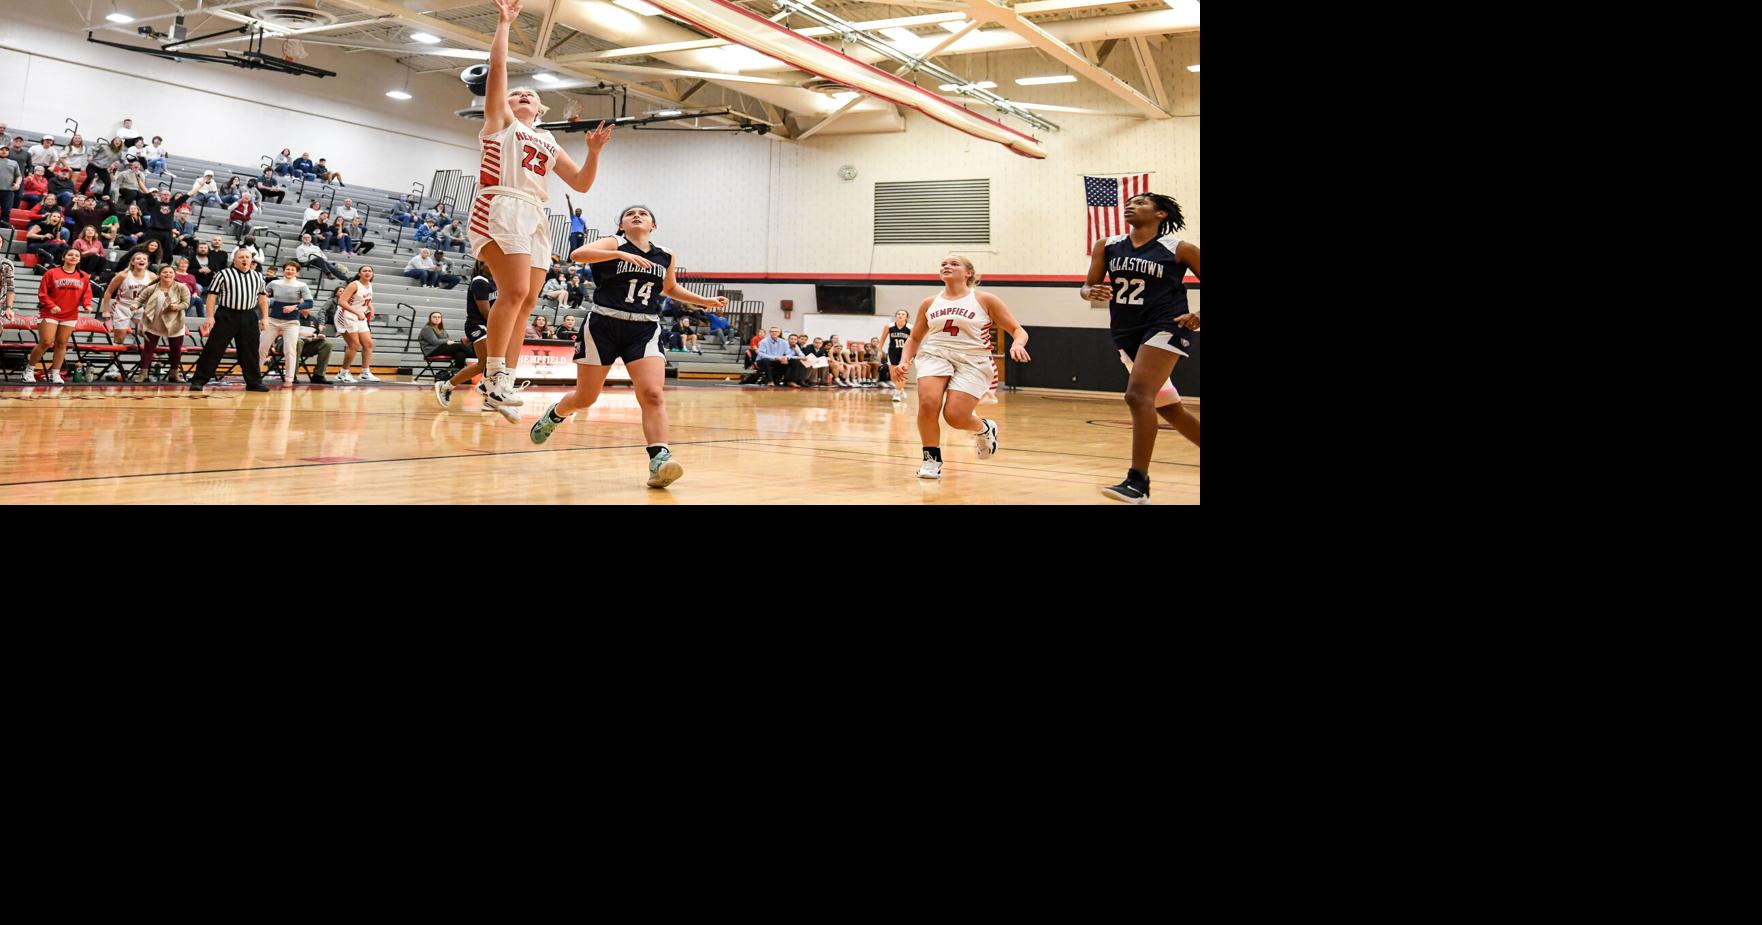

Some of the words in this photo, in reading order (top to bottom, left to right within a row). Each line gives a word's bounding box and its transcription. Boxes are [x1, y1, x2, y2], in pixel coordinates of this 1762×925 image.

[522, 144, 549, 177] 23
[624, 278, 655, 306] 14
[1115, 277, 1146, 306] 22
[930, 307, 976, 320] HEMPFIELD
[943, 319, 960, 336] 4
[894, 338, 905, 348] 10
